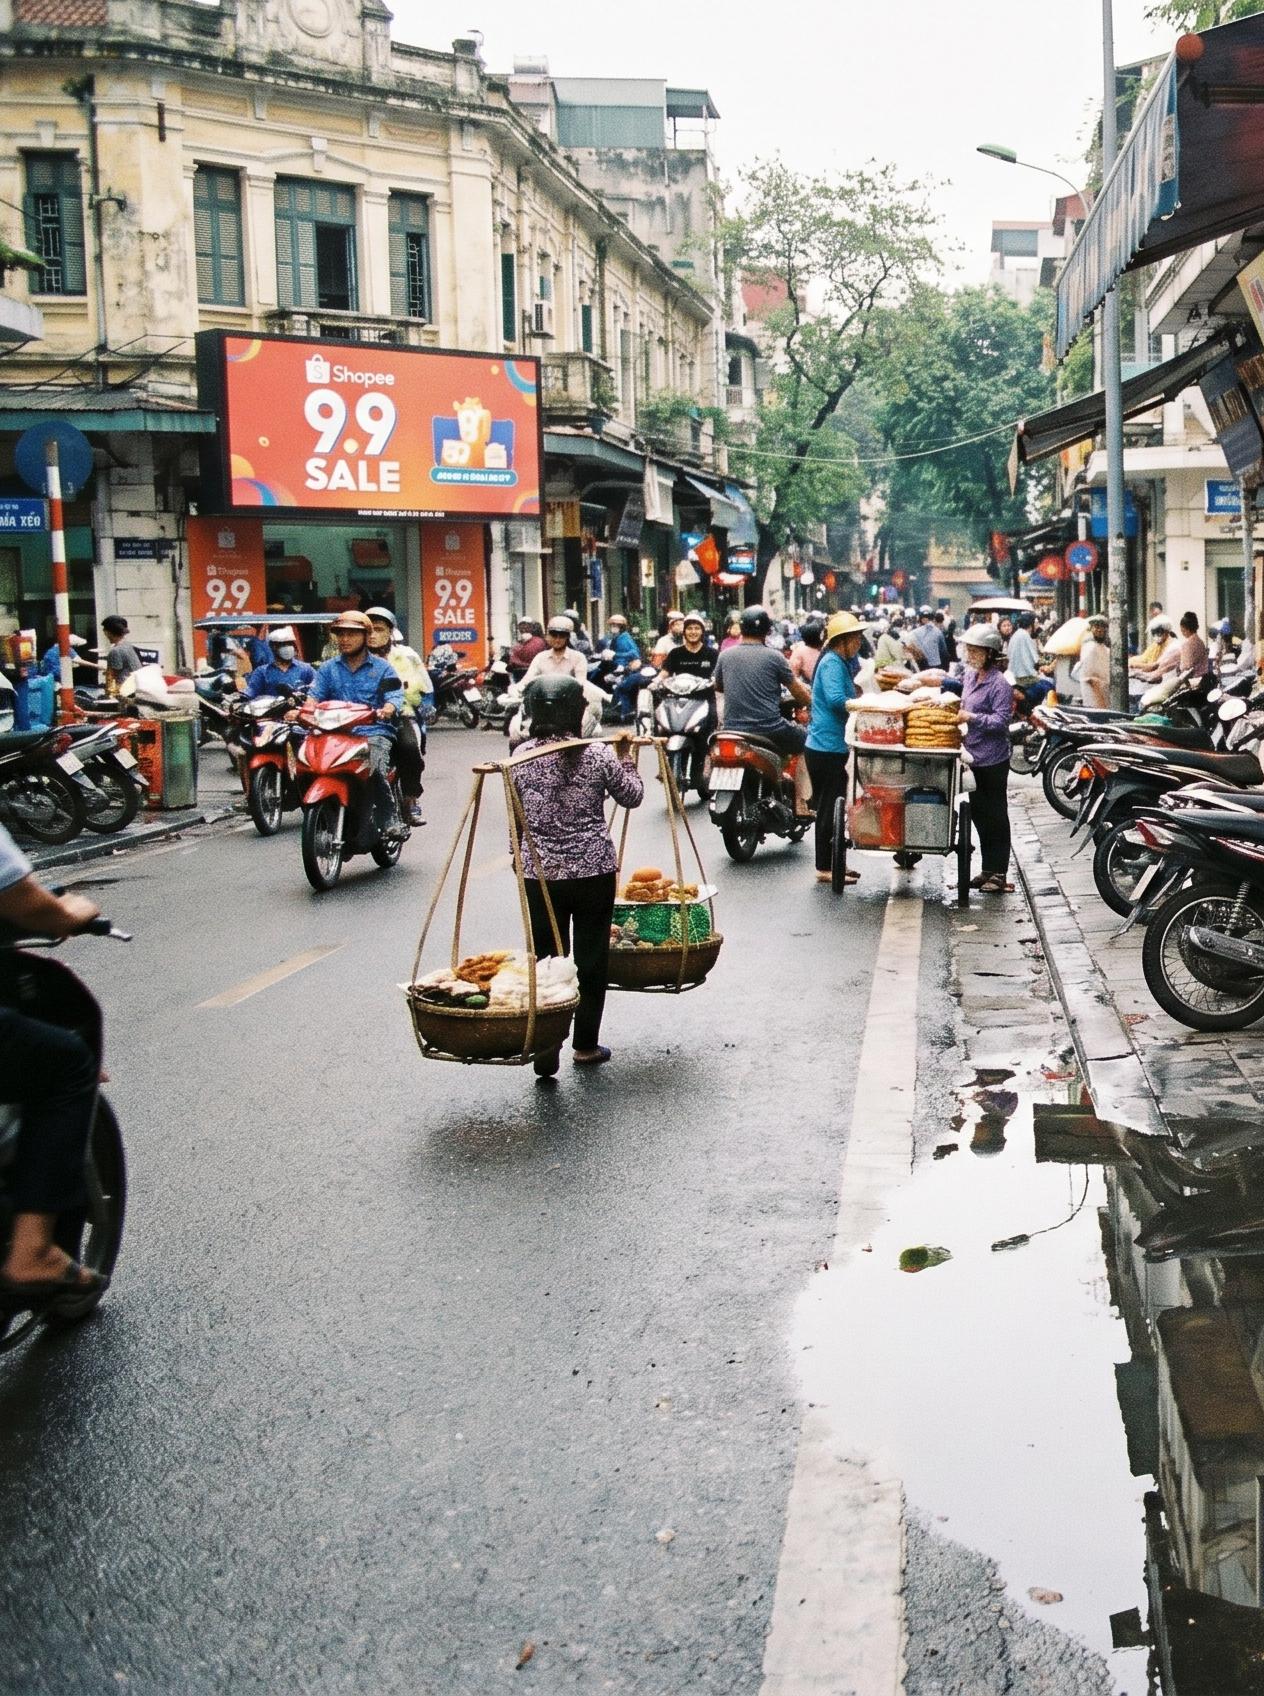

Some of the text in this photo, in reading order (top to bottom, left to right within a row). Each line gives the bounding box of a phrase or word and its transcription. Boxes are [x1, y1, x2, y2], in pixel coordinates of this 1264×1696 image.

[333, 364, 395, 388] Shopee
[303, 388, 398, 456] 9.9
[305, 457, 401, 493] SALE
[206, 578, 251, 609] 9.9
[434, 578, 473, 608] 9.9
[433, 608, 476, 625] SALE
